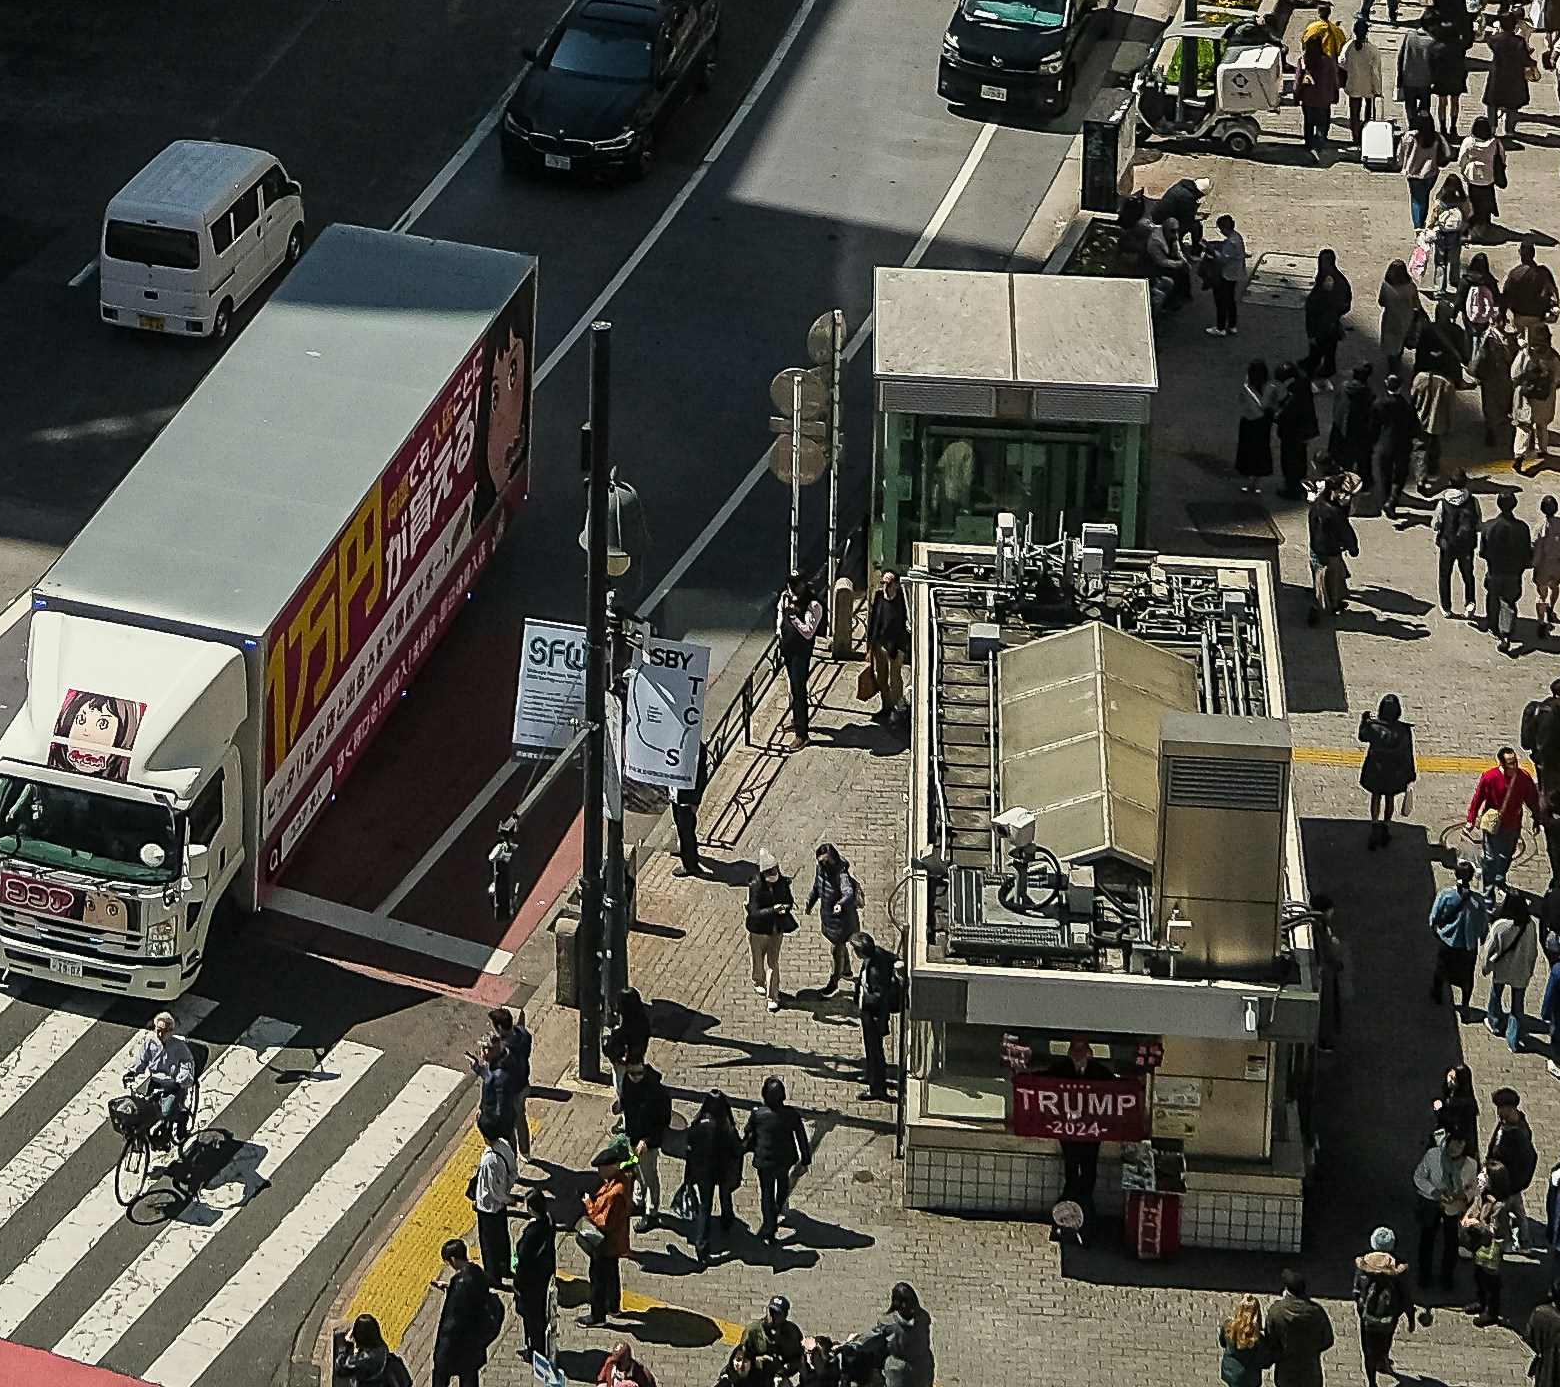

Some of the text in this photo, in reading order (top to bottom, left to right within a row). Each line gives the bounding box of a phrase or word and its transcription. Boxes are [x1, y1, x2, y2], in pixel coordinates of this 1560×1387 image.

[267, 477, 383, 771] 1万円
[650, 649, 695, 671] SBY
[6, 878, 75, 913] ココア
[1016, 1087, 1138, 1117] TRUMP
